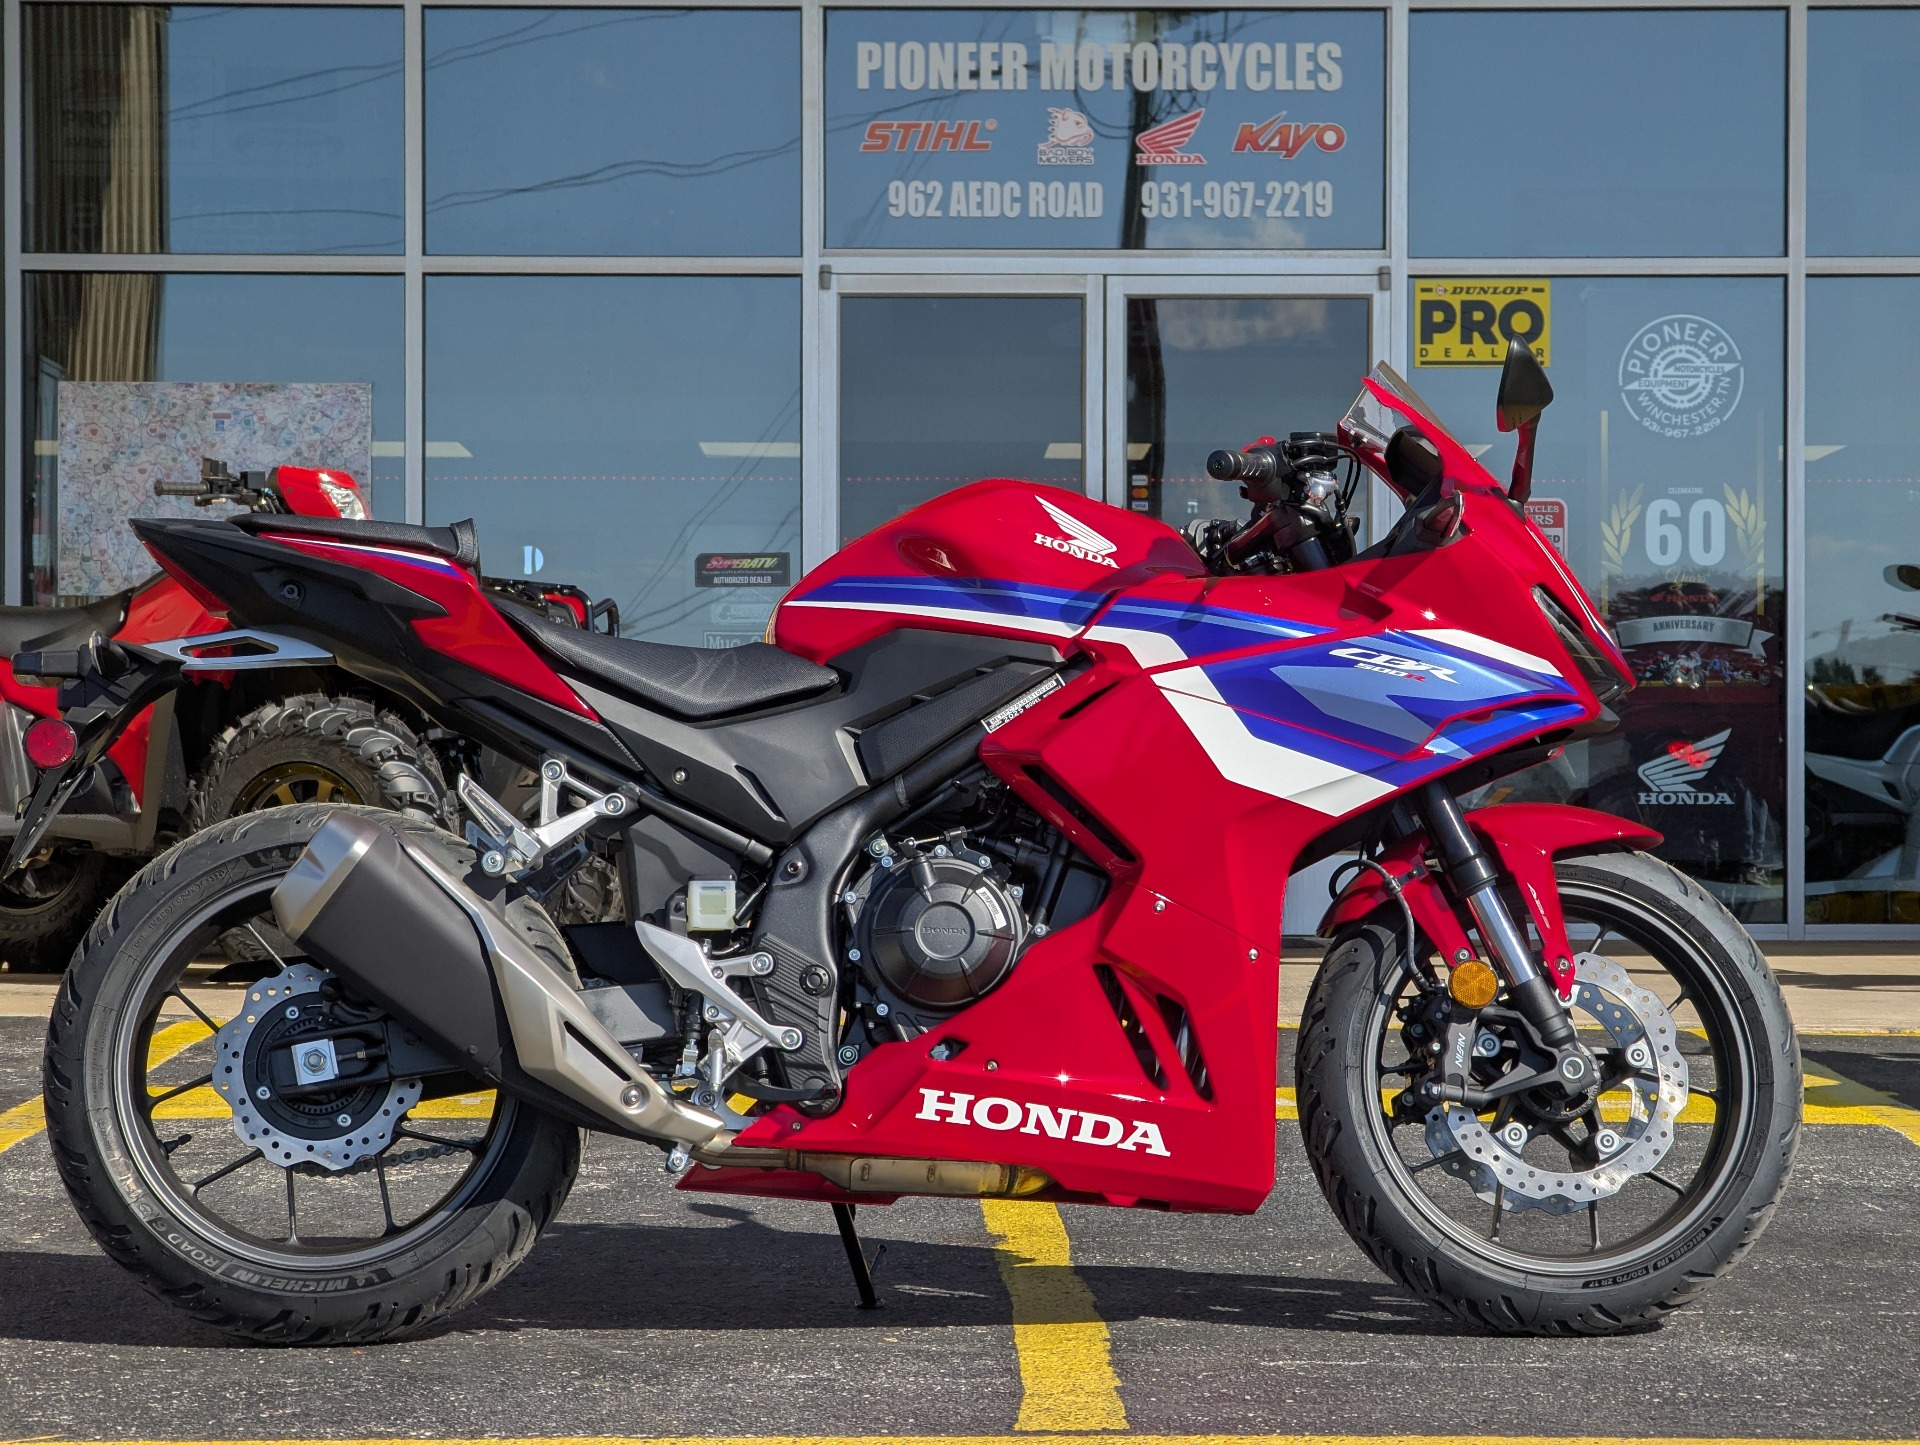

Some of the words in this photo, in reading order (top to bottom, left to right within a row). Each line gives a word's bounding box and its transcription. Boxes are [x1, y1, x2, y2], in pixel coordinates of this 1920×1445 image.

[856, 41, 1028, 91] PIONEER
[1040, 41, 1343, 92] MOTORCYCLES
[860, 120, 992, 152] STIHL
[1232, 110, 1347, 160] KAYO
[1038, 156, 1093, 164] MOWERS
[1136, 154, 1207, 165] HONDA
[888, 180, 943, 217] 962
[949, 180, 1022, 218] AEDC
[1028, 181, 1104, 218] ROAD
[1141, 180, 1333, 219] 931-967-2219
[1450, 286, 1529, 295] DUNLOP
[1420, 298, 1545, 346] PRO
[1420, 347, 1545, 358] DEALR
[1627, 321, 1729, 375] PIONEER
[1638, 380, 1690, 388] EQUIPMENT
[1716, 376, 1732, 395] TN
[1642, 417, 1721, 438] 931-967-2219
[1524, 505, 1560, 513] CYCLES
[1645, 499, 1726, 566] 60
[1033, 532, 1120, 569] HONDA
[713, 576, 749, 584] AUTHORIZED
[1653, 619, 1715, 632] ANNIVERSARY
[1328, 647, 1460, 685] CBR
[1354, 662, 1426, 682] 500R
[1003, 707, 1024, 724] 2025
[1024, 697, 1042, 709] MODEL
[1638, 792, 1735, 805] HONDA
[922, 926, 968, 935] HONDA
[915, 1087, 1171, 1157] HONDA
[152, 1219, 168, 1233] 6
[167, 1233, 220, 1268] ROAD
[1657, 1230, 1707, 1268] MICHELIN
[231, 1268, 350, 1291] MICHELIN
[1616, 1269, 1647, 1283] 120/70
